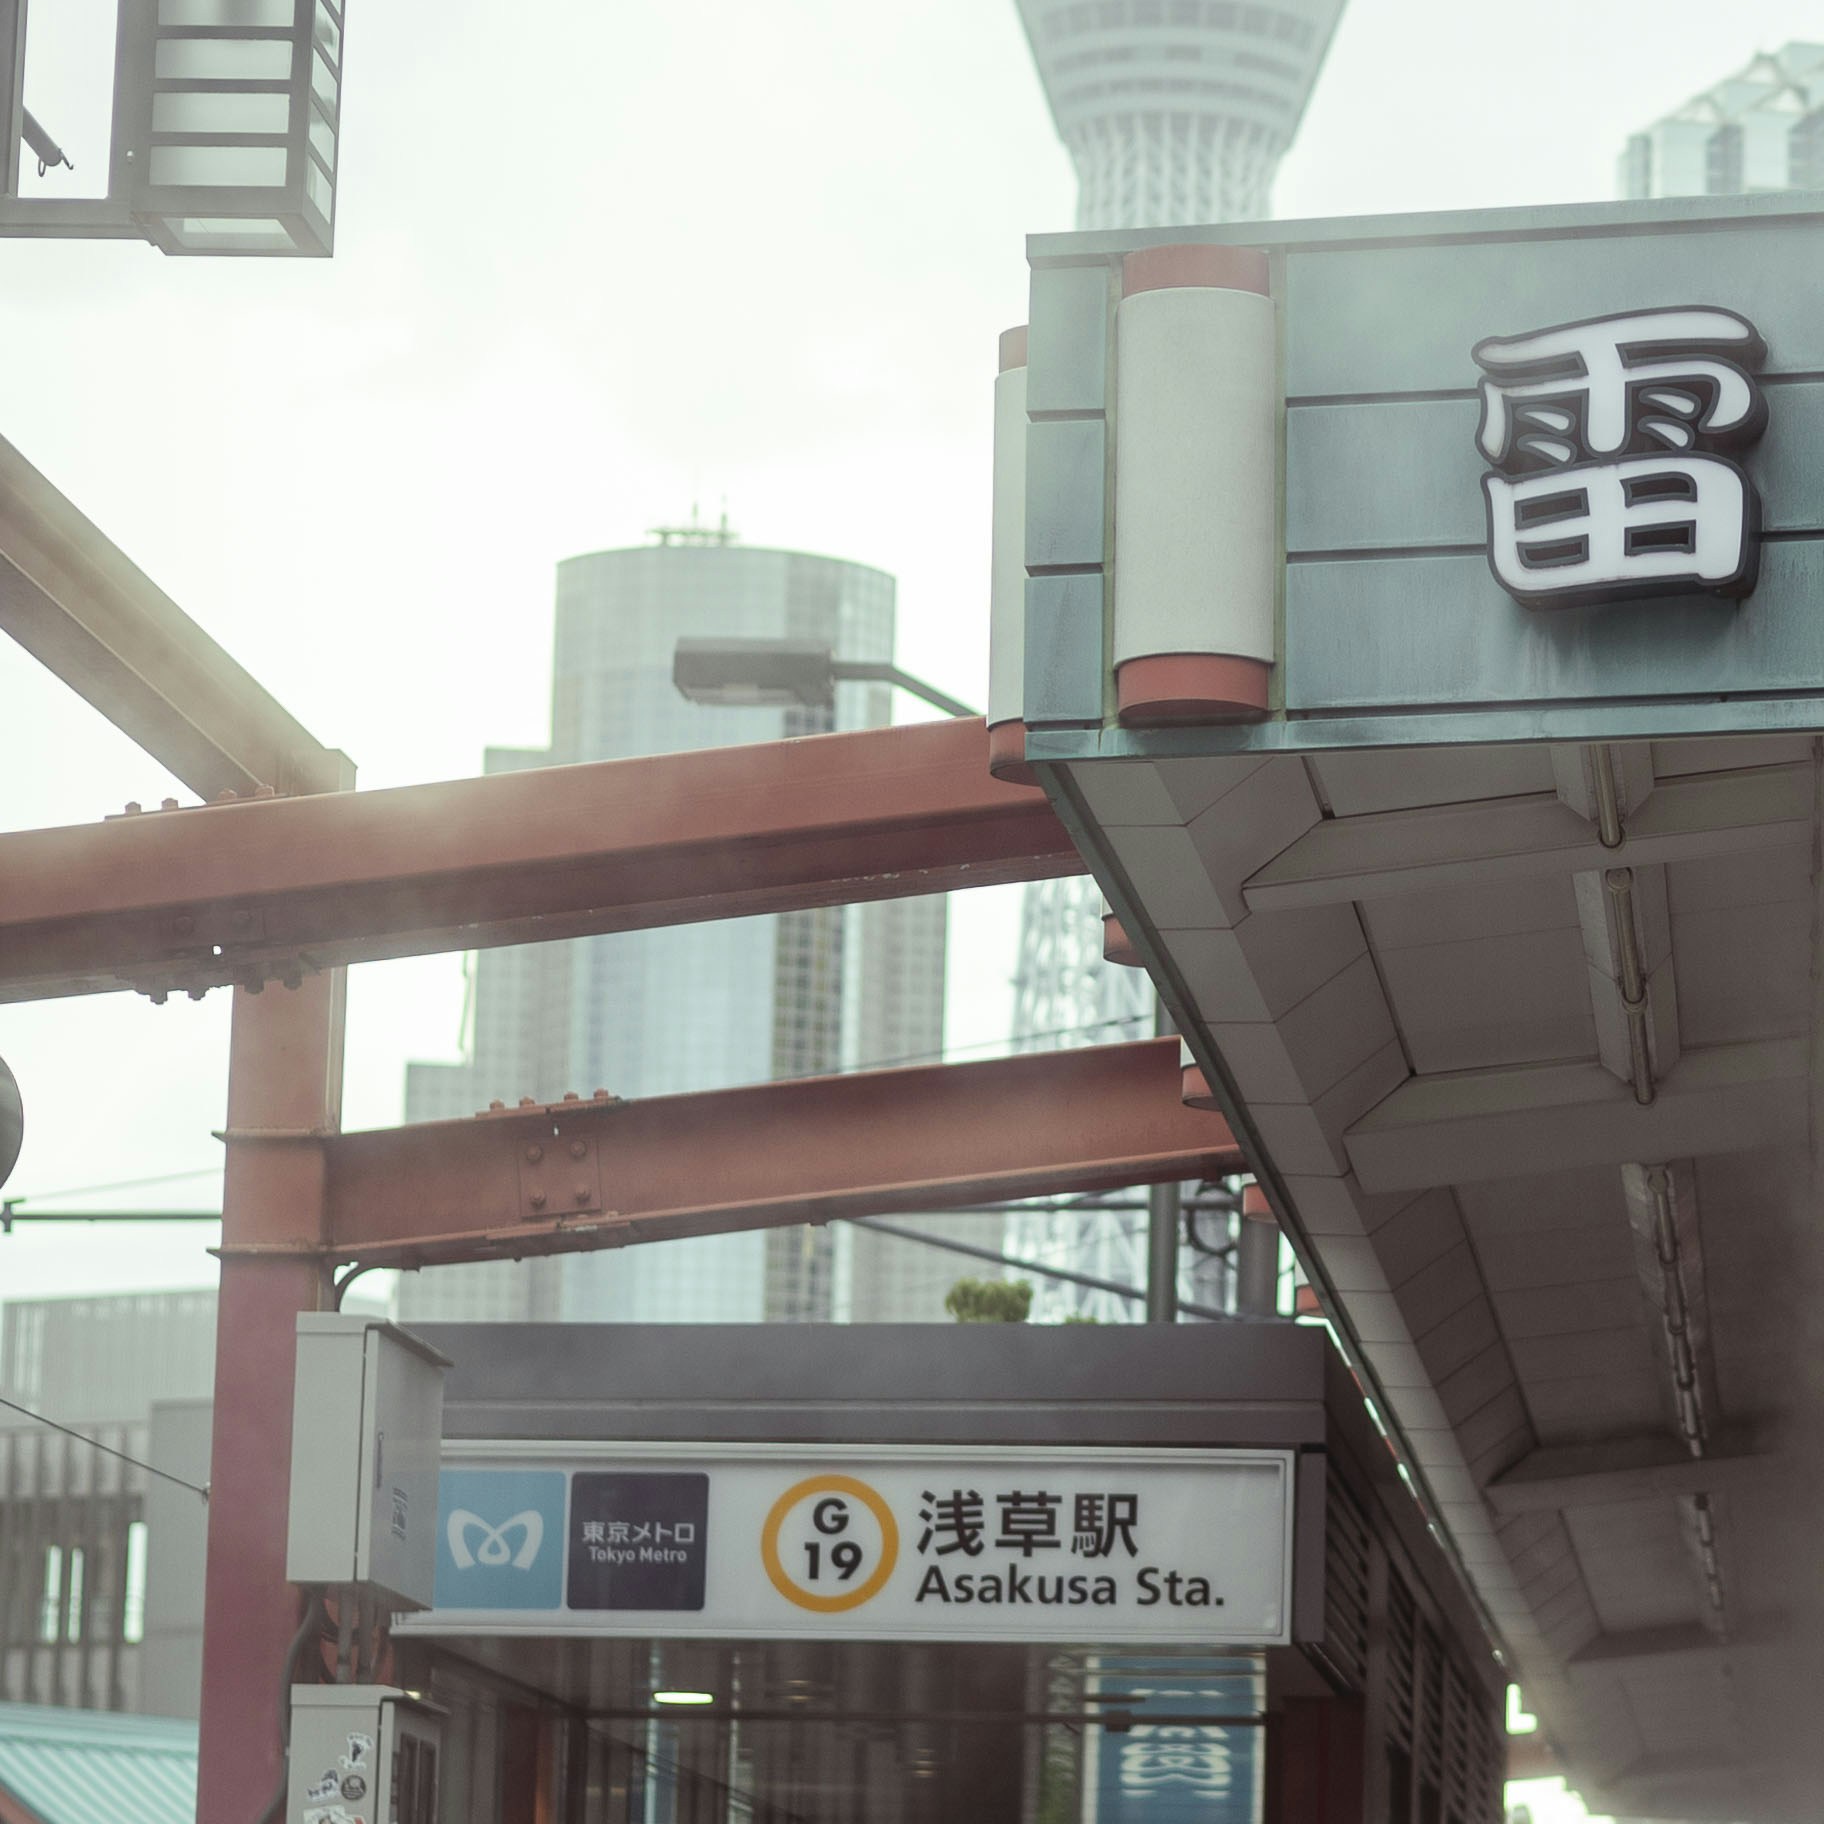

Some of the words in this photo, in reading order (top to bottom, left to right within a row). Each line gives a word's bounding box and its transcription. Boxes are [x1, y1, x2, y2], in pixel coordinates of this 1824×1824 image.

[582, 1521, 695, 1544] 東京メトロ
[812, 1497, 851, 1535] G
[916, 1489, 1140, 1558] 浅草駅
[589, 1546, 636, 1565] Tokyo
[639, 1546, 688, 1563] Metro
[803, 1540, 863, 1580] 19
[915, 1563, 1118, 1604] Asakusa
[1136, 1566, 1226, 1607] Sta.
